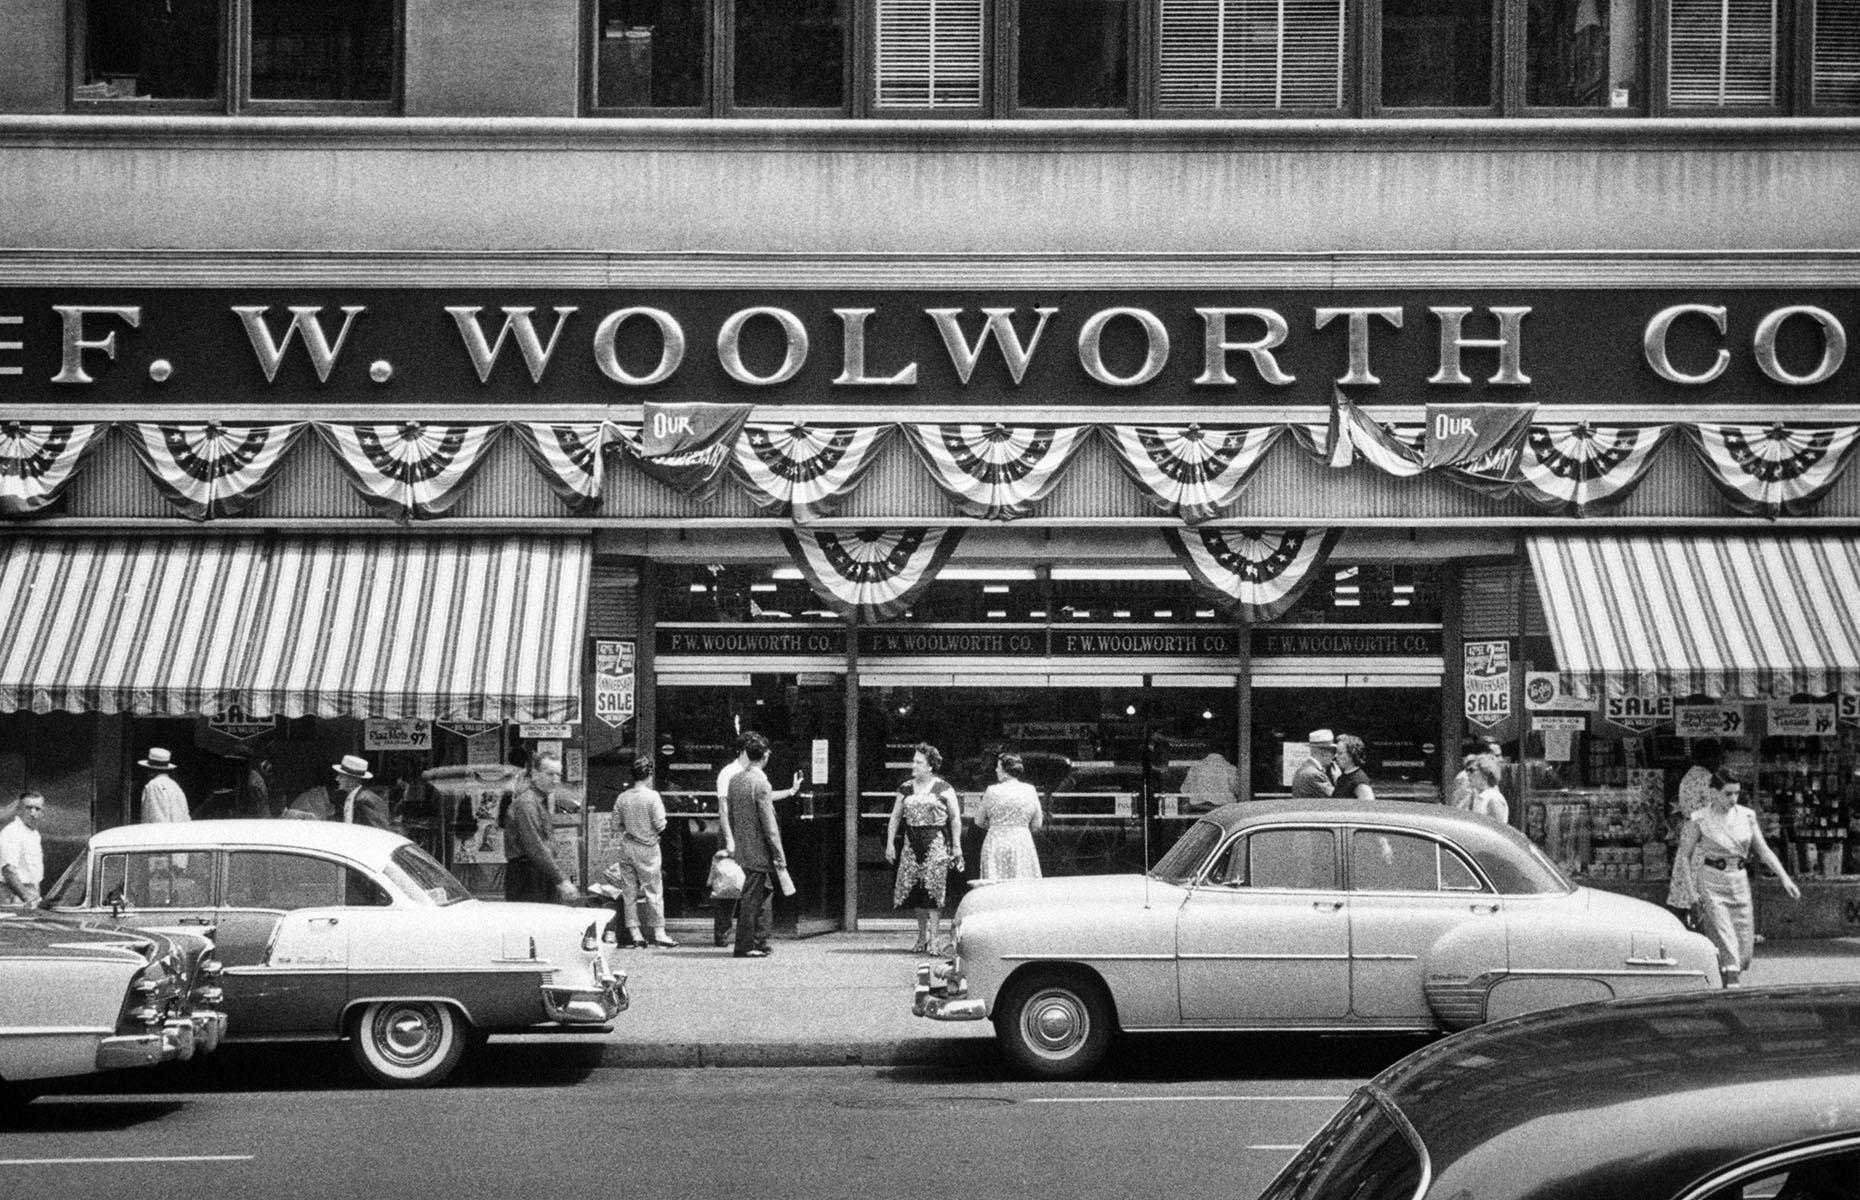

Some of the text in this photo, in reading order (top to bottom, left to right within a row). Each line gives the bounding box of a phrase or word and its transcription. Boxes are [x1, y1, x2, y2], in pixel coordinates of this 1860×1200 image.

[51, 303, 1847, 386] F. W. WOOLWORTH CO
[653, 411, 695, 439] OUR
[1435, 413, 1479, 440] OUR
[702, 635, 801, 650] WOOLWORTH
[808, 635, 832, 650] CO.
[904, 635, 1003, 650] WOOLWORTH
[1081, 636, 1095, 651] W.
[1099, 636, 1197, 651] WOOLWORTH
[1299, 636, 1398, 651] WOOLWORTH
[598, 692, 632, 711] SALE
[1468, 692, 1508, 712] SALE
[1609, 698, 1670, 716] SALE
